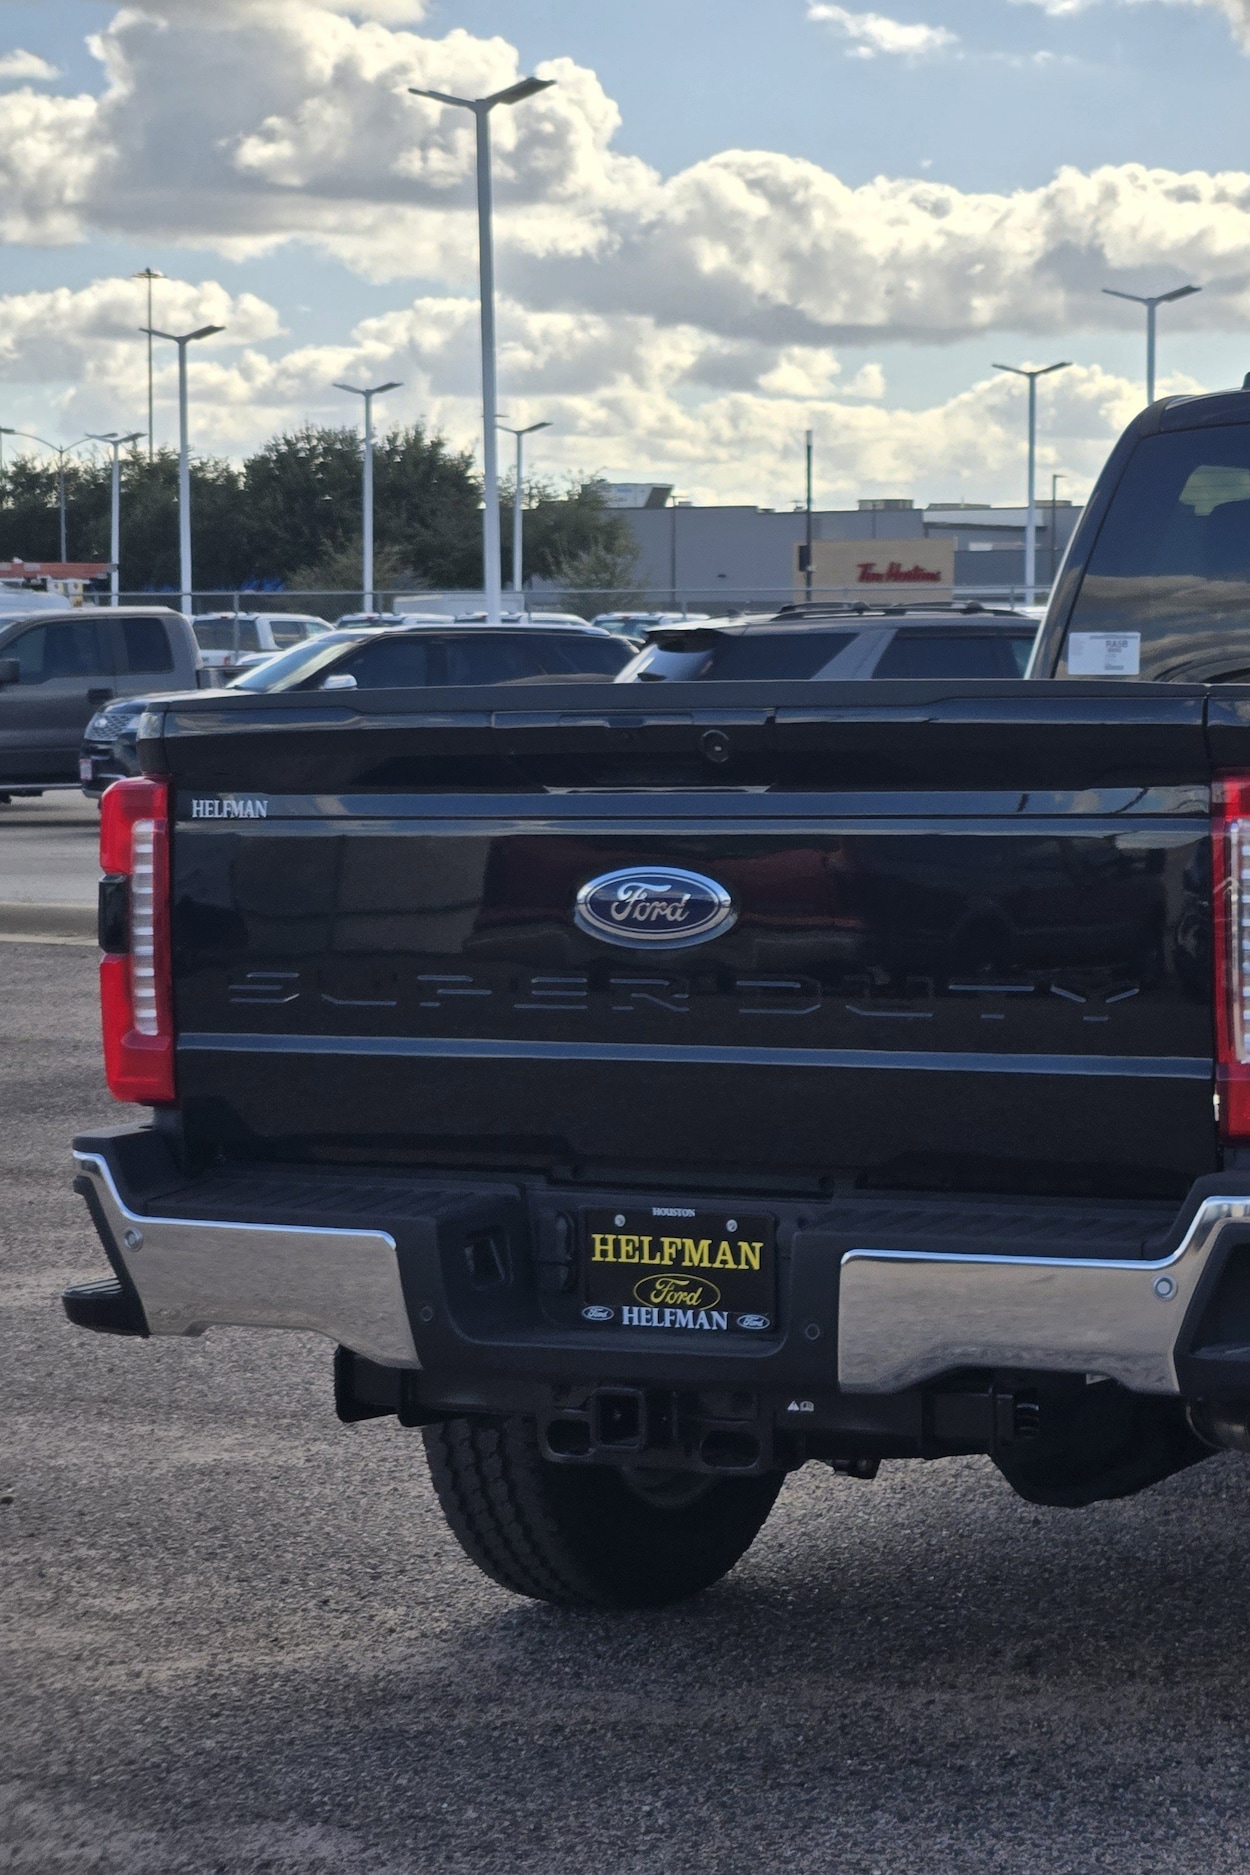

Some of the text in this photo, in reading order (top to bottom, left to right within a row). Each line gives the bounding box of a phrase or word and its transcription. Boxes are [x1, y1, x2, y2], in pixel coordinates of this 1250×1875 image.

[191, 799, 268, 818] HELFMAN
[610, 881, 692, 922] Ford
[652, 1206, 696, 1217] HOUSTON
[591, 1233, 764, 1270] HELFMAN
[651, 1277, 703, 1306] Ford
[622, 1305, 729, 1331] HELFMAN
